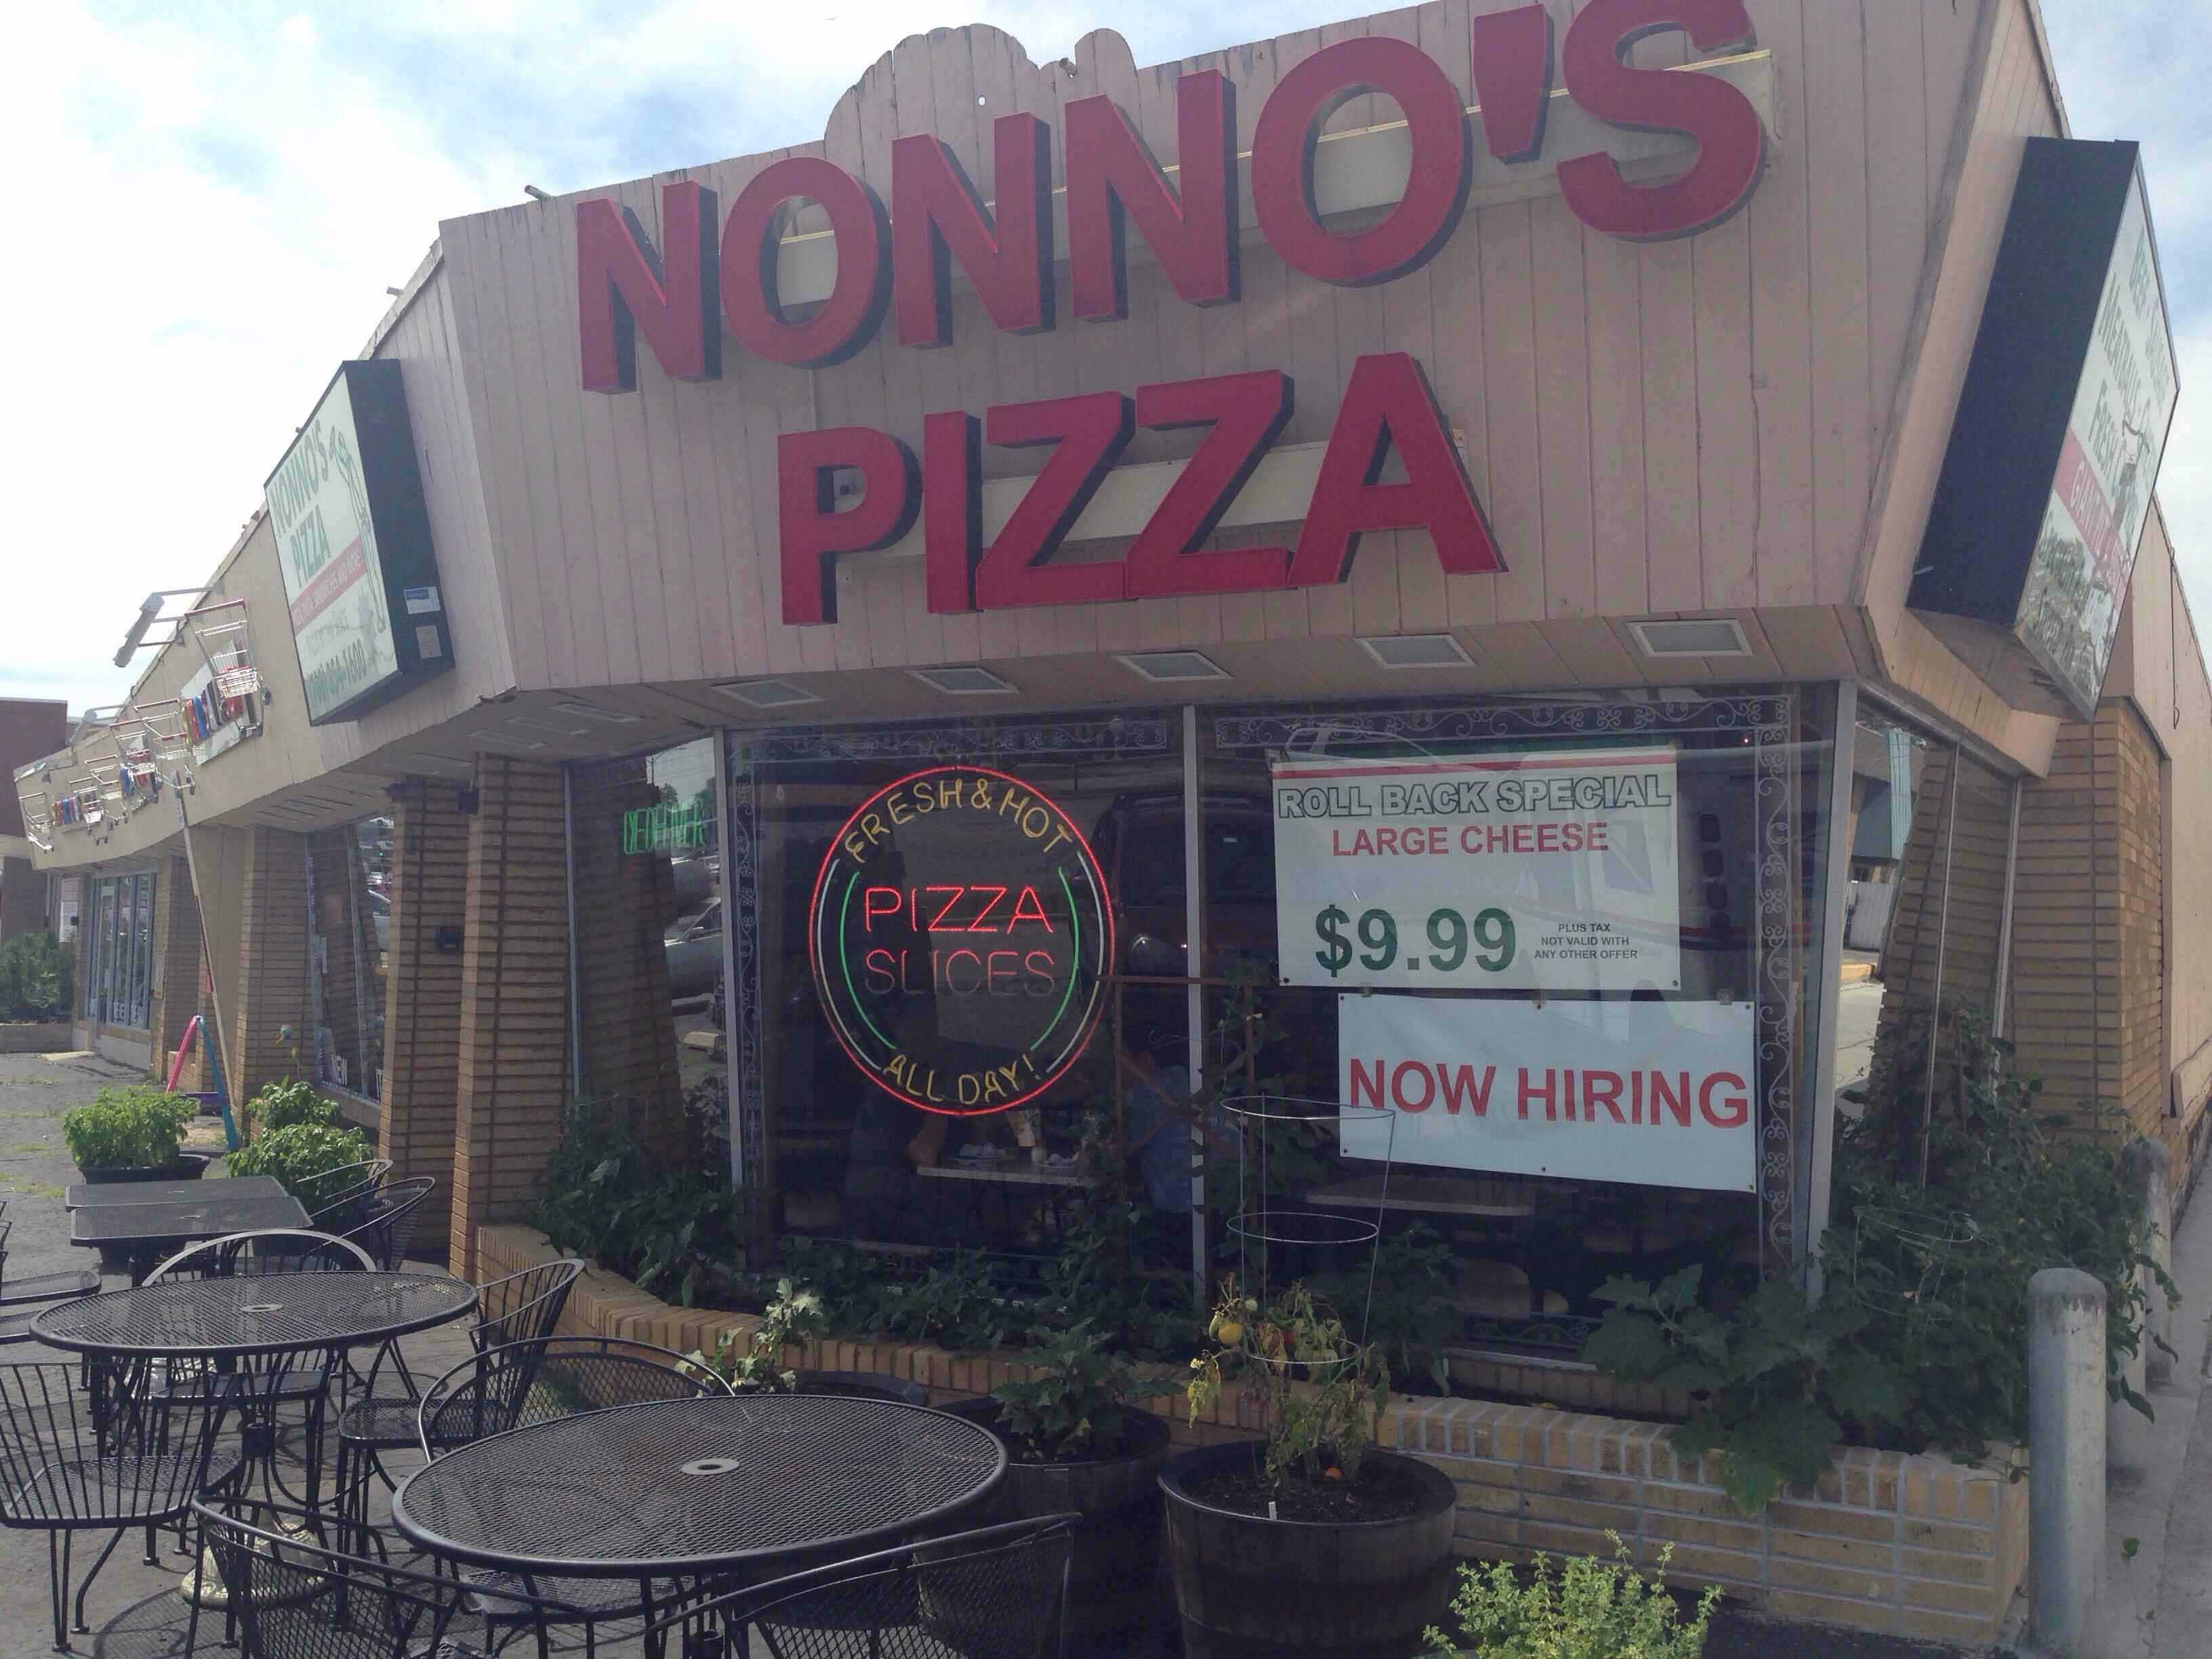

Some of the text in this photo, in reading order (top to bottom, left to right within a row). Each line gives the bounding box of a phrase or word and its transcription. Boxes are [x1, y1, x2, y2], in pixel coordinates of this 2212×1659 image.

[575, 0, 1766, 394] NONNO'S
[2097, 267, 2142, 432] MEATBALLS
[2088, 377, 2121, 485] FRESH
[270, 419, 329, 539] NONNO'S
[777, 352, 1509, 625] PIZZA
[290, 504, 331, 590] PIZZA
[844, 778, 1074, 863] FRESH & HOT
[1277, 774, 1672, 819] ROLL BACK SPECIAL
[1332, 821, 1609, 856] LARGE CHEESE
[864, 885, 1054, 935] PIZZA
[1315, 904, 1517, 977] $9.99
[1541, 937, 1629, 946] NOT VALID WITH
[1559, 923, 1611, 933] PLUS TAX
[865, 949, 1057, 997] SLICES
[1534, 949, 1638, 959] ANY OTHER OFFER
[882, 1052, 1042, 1105] ALL DAY!
[1349, 1058, 1749, 1129] NOW HIRING
